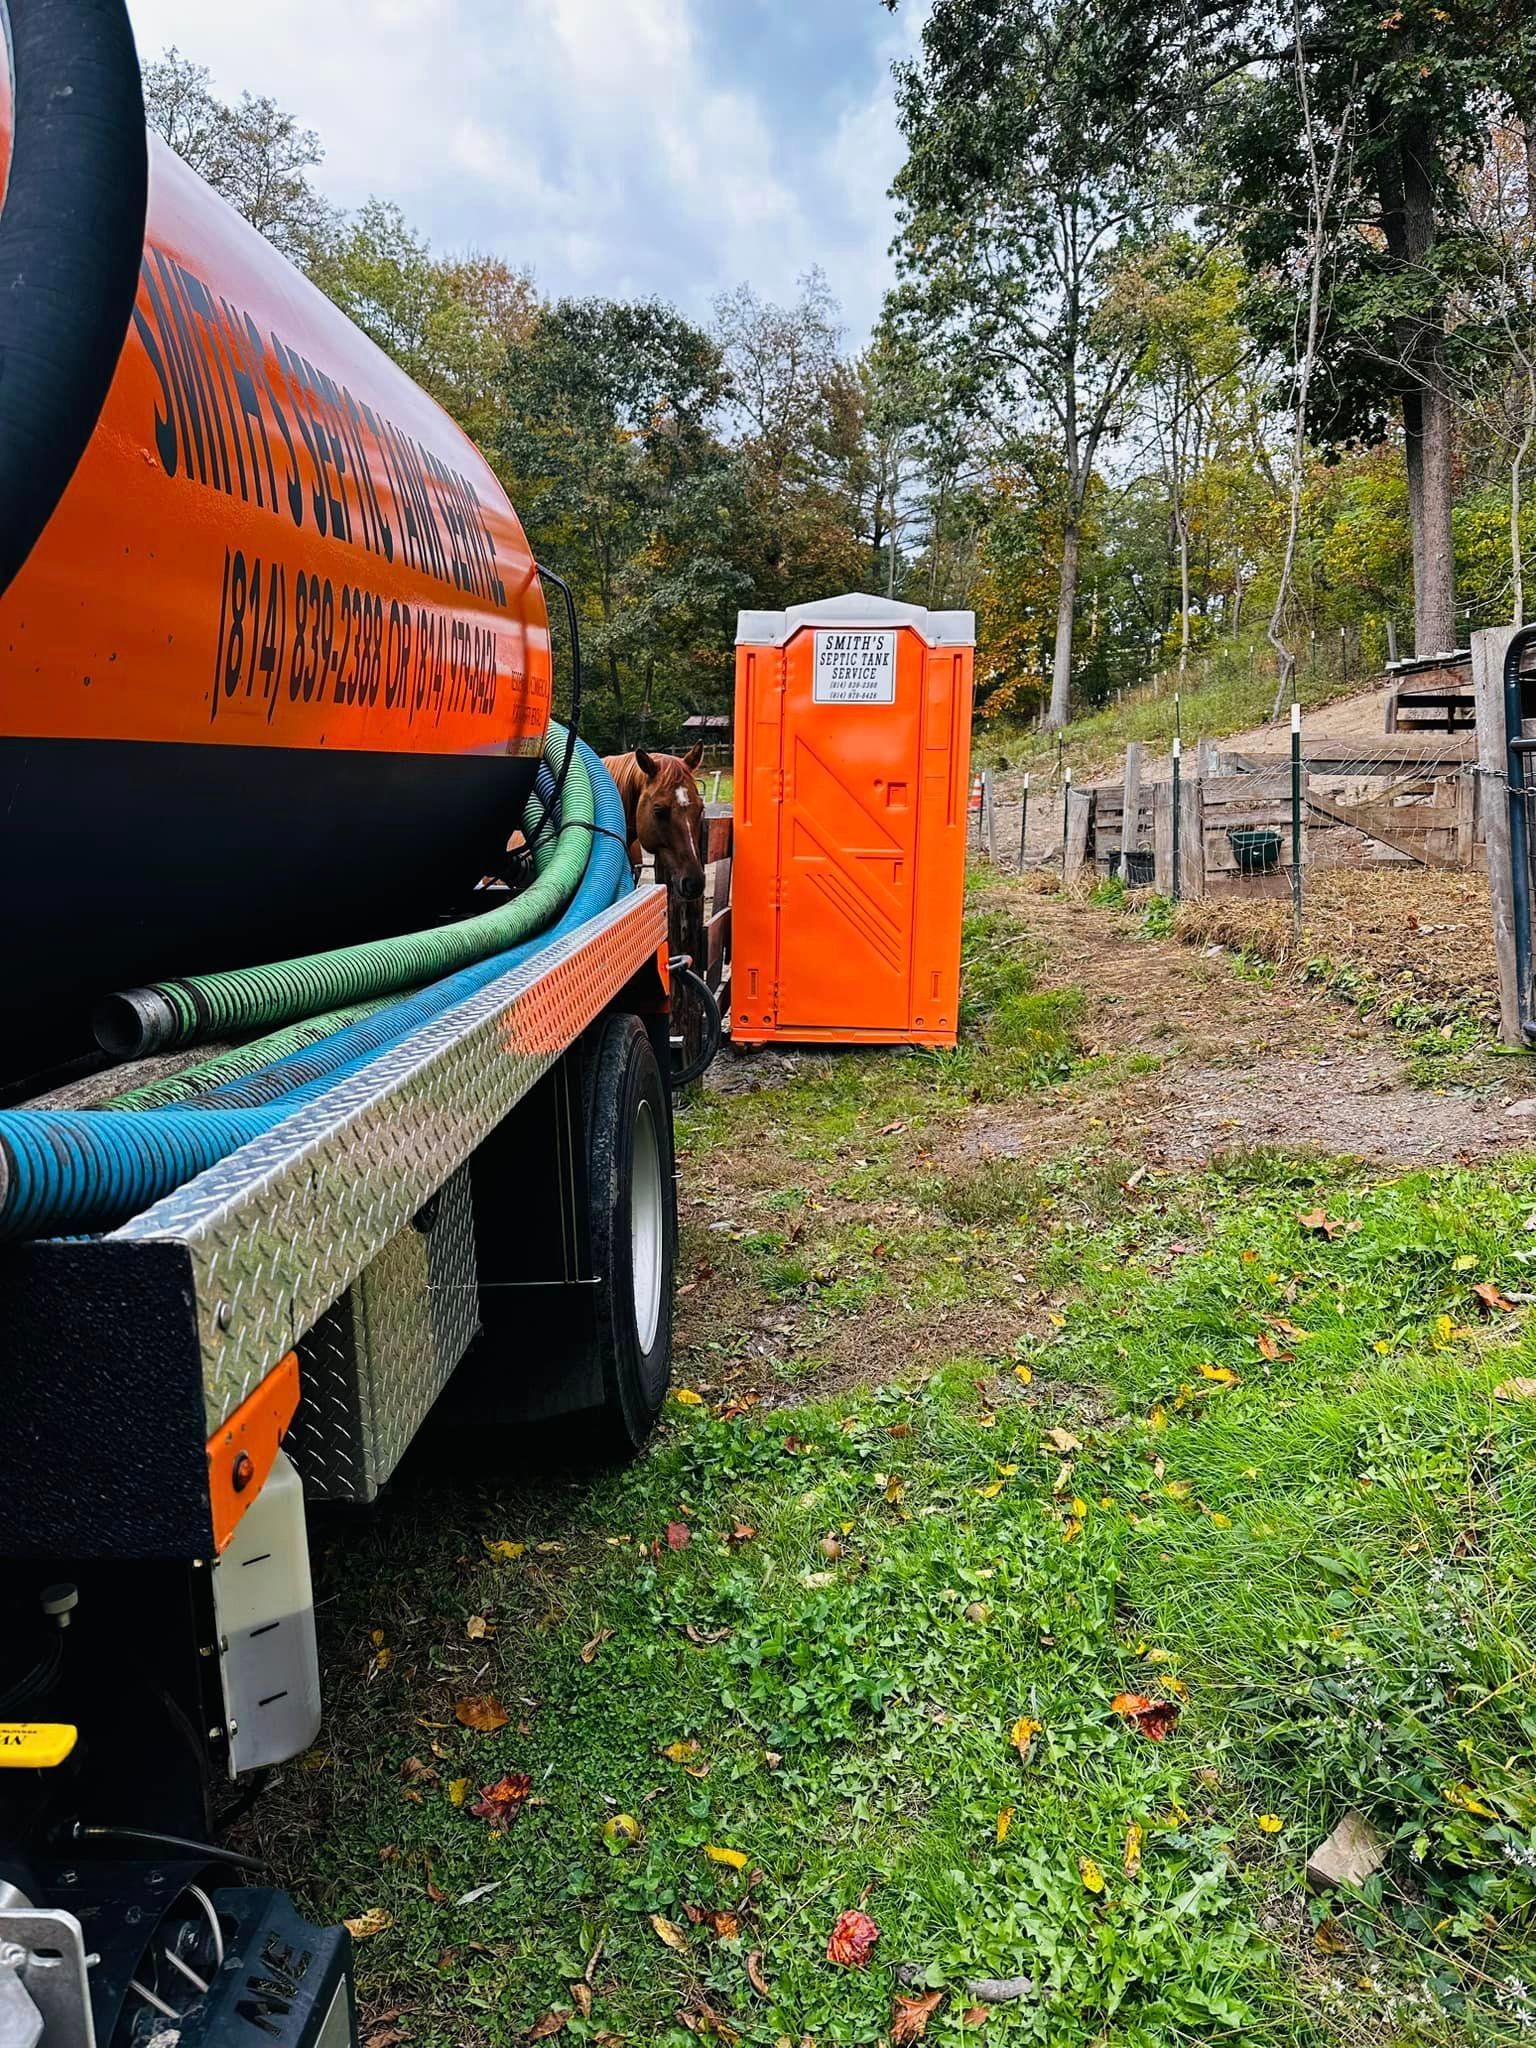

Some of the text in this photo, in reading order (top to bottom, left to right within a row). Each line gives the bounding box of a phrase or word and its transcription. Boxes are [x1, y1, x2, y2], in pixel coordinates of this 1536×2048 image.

[133, 247, 507, 608] SMITH'S SEPTIC TANK SERVICE
[210, 544, 287, 725] (814)
[289, 569, 383, 708] 839-2388
[385, 598, 412, 710] OR
[407, 606, 448, 729] (814)
[825, 635, 885, 650] SMITH'S
[820, 652, 890, 666] SEPTIC TANK
[832, 667, 877, 680] SERVICE
